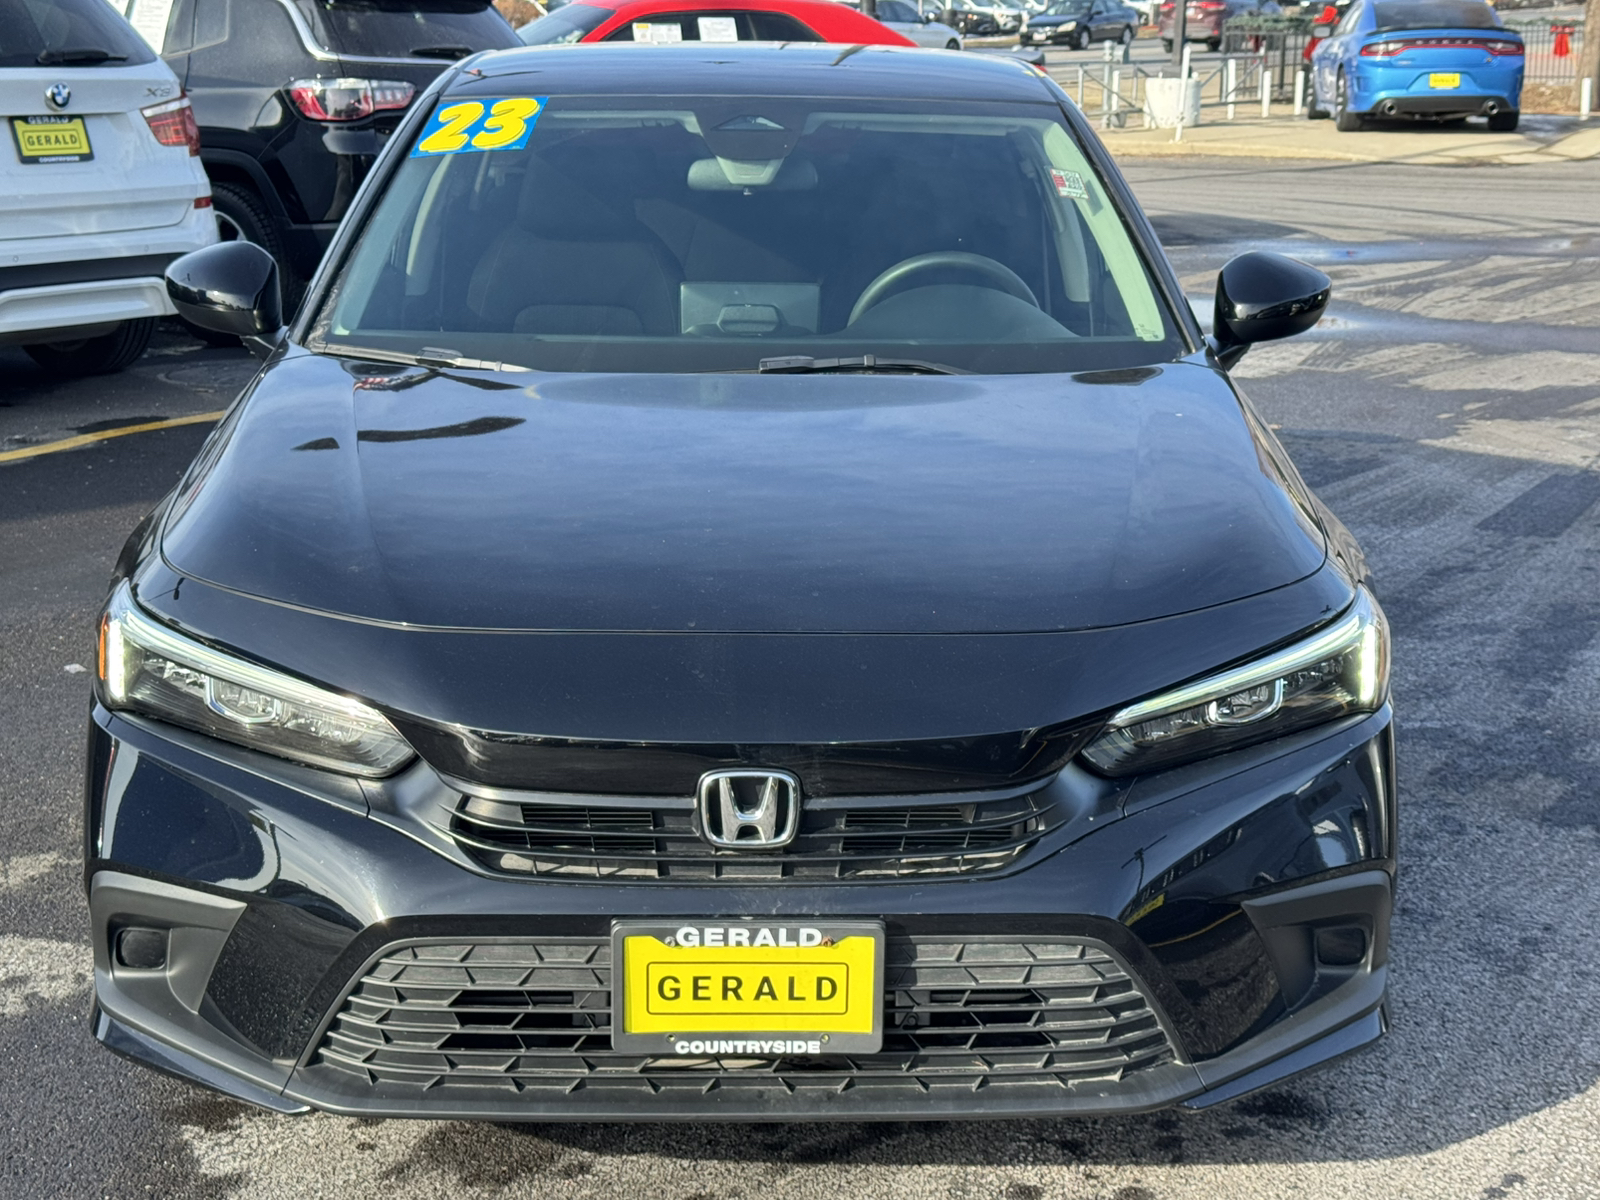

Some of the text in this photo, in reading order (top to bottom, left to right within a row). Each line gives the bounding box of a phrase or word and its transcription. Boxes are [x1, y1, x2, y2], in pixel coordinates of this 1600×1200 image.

[419, 98, 540, 153] 23
[27, 134, 78, 146] GERALD
[675, 927, 822, 948] GERALD
[657, 975, 838, 1001] GERALD
[675, 1040, 821, 1055] COUNTRYSIDE
